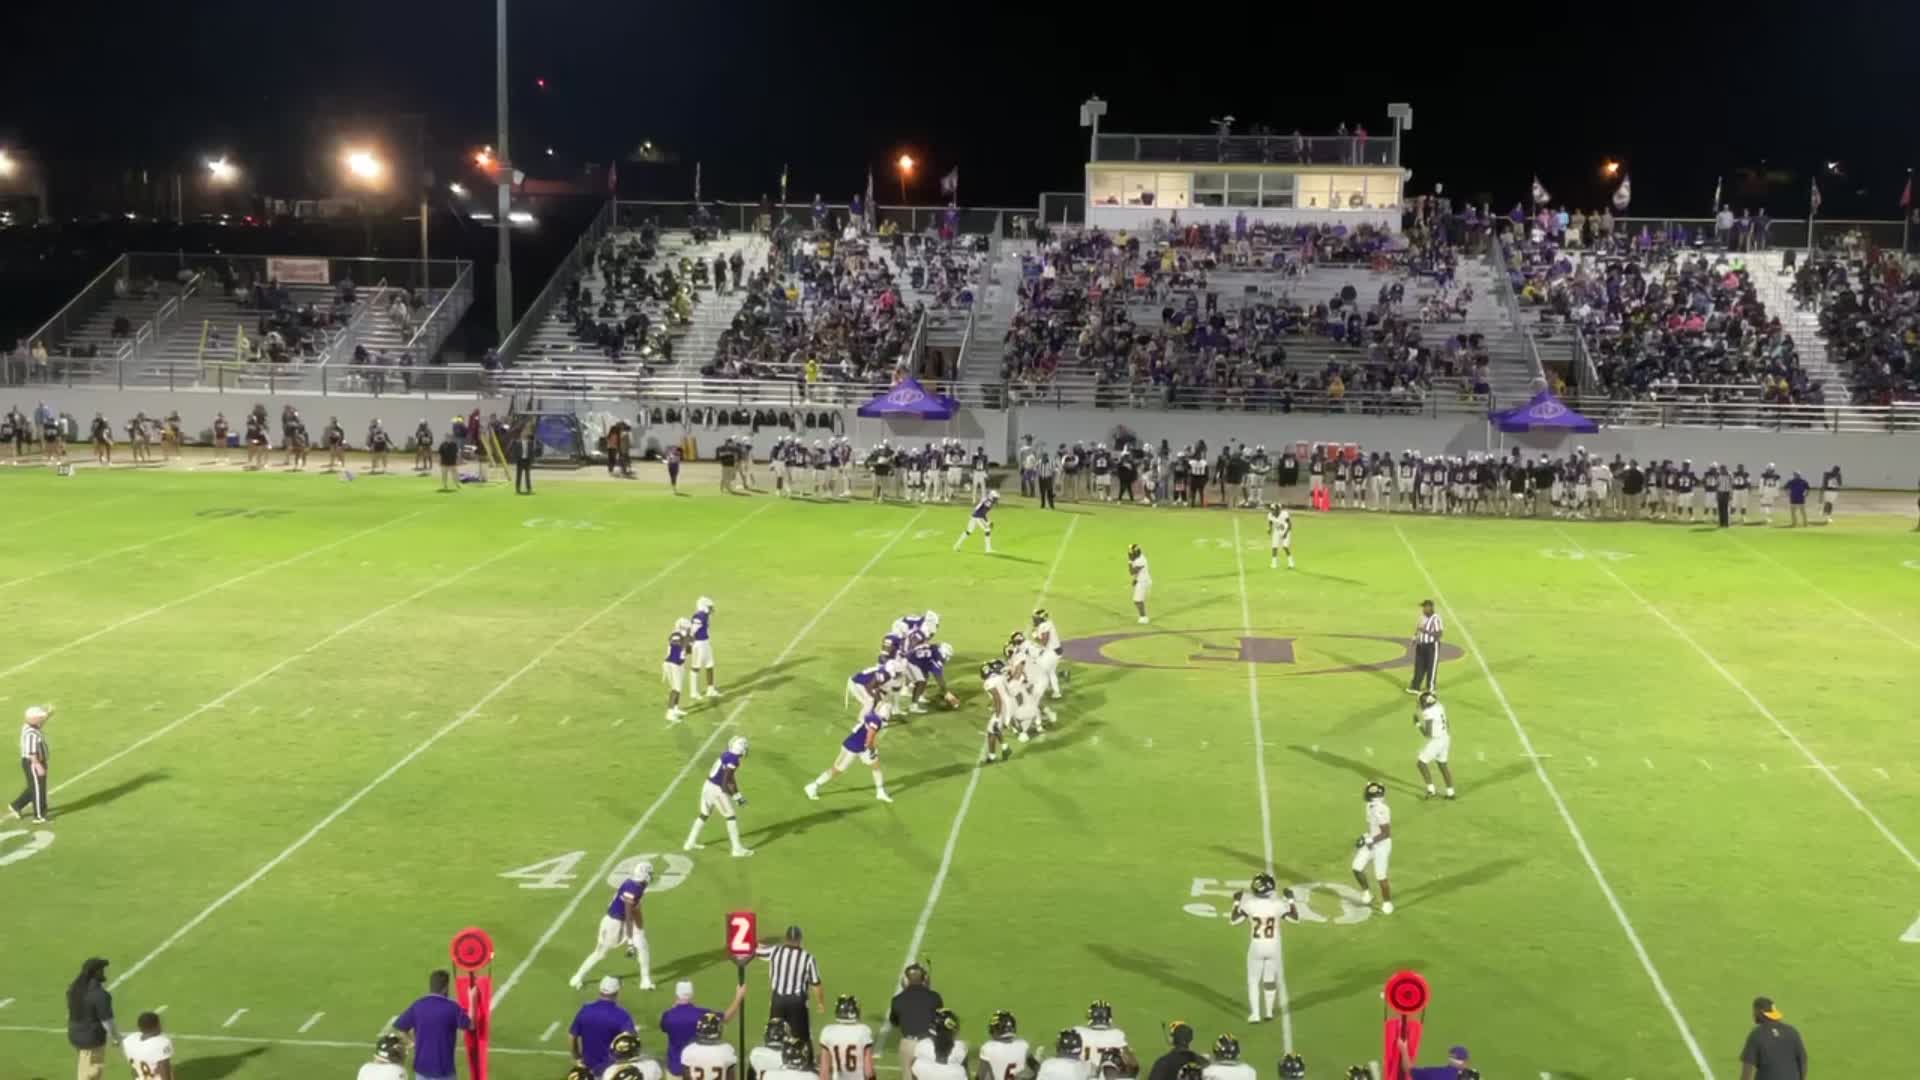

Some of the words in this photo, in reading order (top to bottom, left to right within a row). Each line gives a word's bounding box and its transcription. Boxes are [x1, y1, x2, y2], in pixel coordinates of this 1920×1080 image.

[497, 851, 695, 892] 40
[731, 917, 750, 950] 2
[1252, 916, 1276, 939] 28
[832, 1045, 858, 1072] 16
